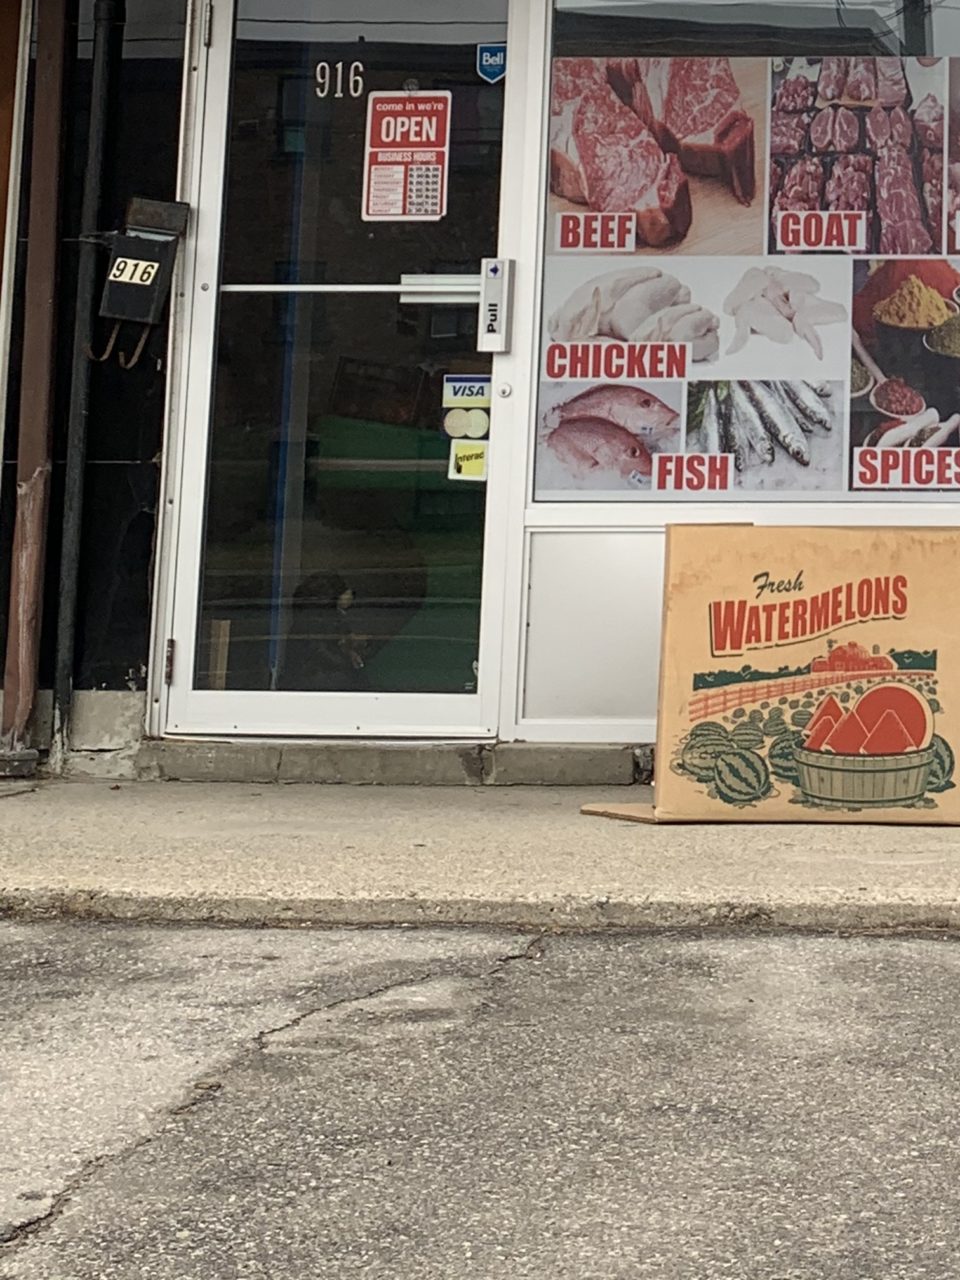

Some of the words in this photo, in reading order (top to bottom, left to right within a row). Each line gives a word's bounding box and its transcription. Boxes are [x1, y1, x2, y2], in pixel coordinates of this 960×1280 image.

[482, 52, 504, 65] Bell
[316, 61, 364, 98] 916
[376, 103, 403, 111] come
[405, 102, 415, 111] in
[417, 101, 444, 111] we're
[381, 116, 436, 143] OPEN
[378, 152, 412, 162] BUSINESS
[413, 152, 437, 162] HOURS
[560, 216, 633, 249] BEEF
[780, 214, 862, 247] GOAT
[113, 260, 155, 282] 916
[487, 303, 498, 333] Pull
[546, 344, 687, 380] CHICKEN
[452, 385, 485, 397] VISA
[455, 451, 484, 463] Interac
[657, 456, 729, 491] FISH
[753, 570, 803, 599] Fresh
[711, 575, 907, 652] WATERMELONS
